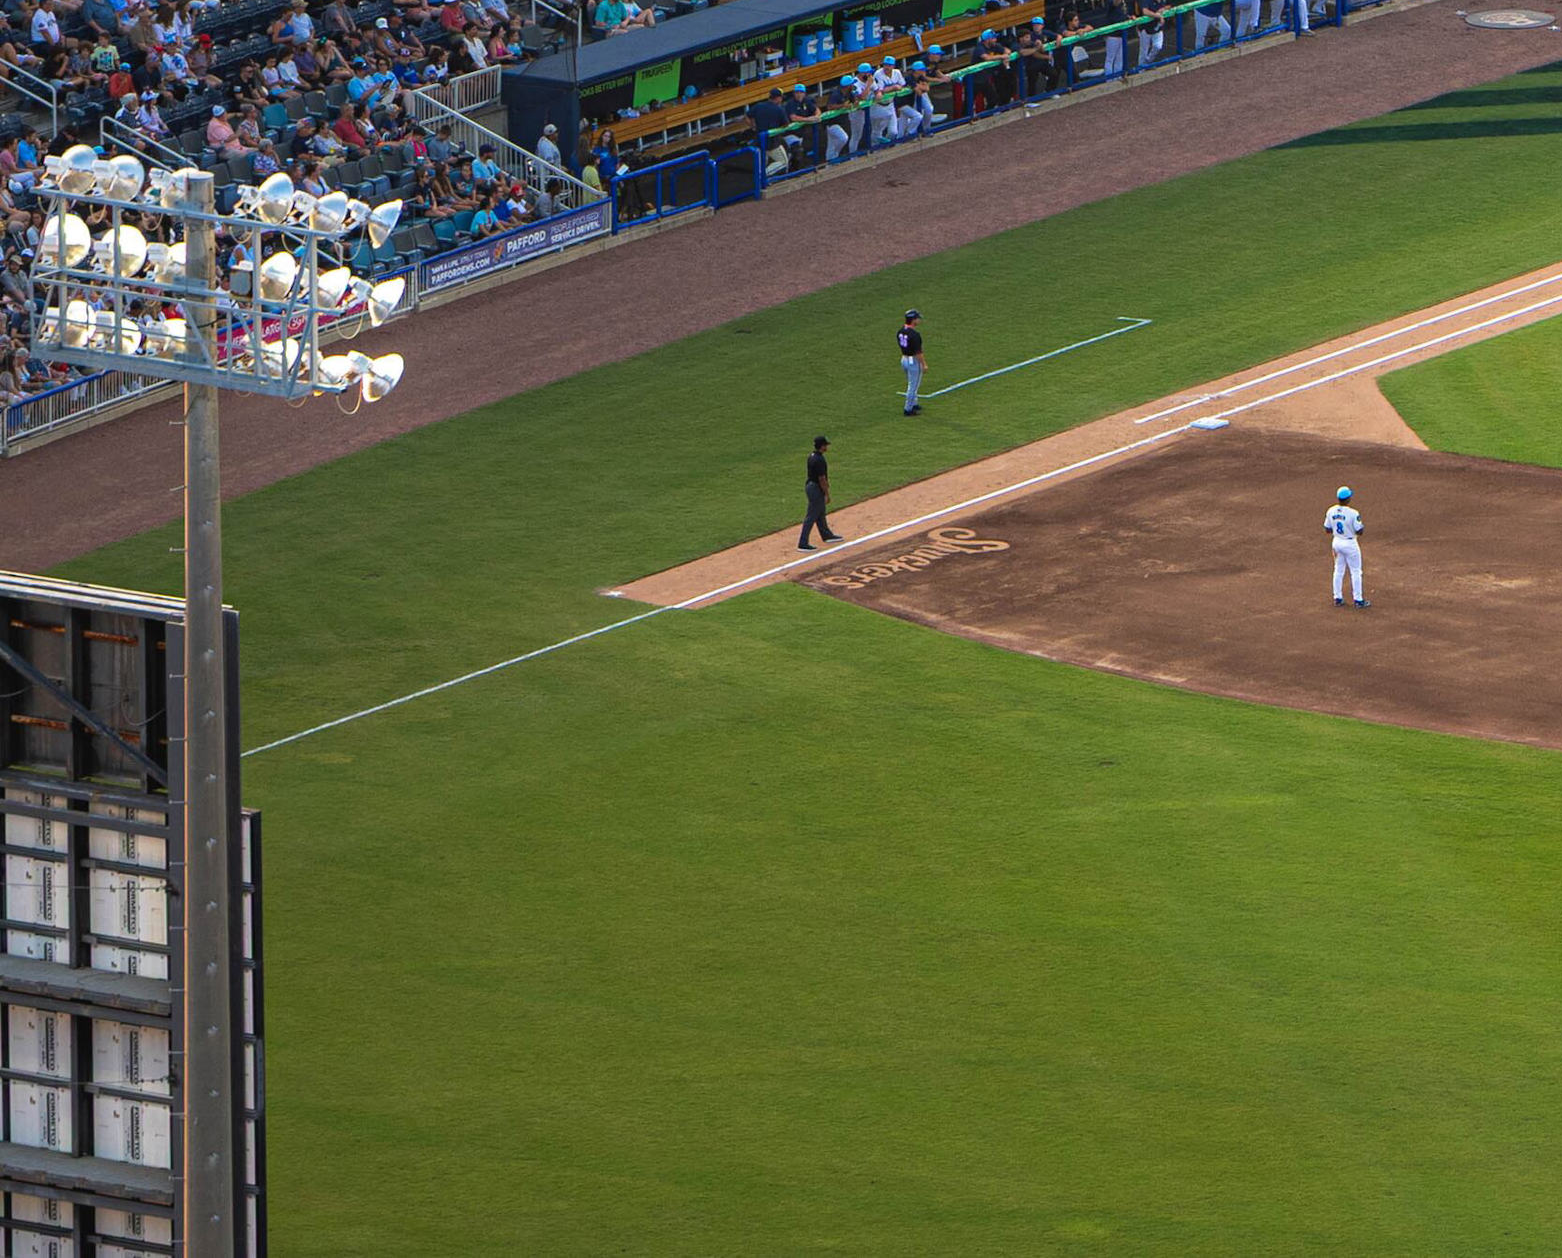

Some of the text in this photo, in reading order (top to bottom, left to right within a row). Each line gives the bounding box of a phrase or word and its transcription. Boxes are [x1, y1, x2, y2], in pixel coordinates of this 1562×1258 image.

[694, 51, 712, 63] HOME
[507, 230, 546, 253] PAFFORD
[1336, 521, 1344, 535] 8
[822, 526, 1010, 590] Shuckers
